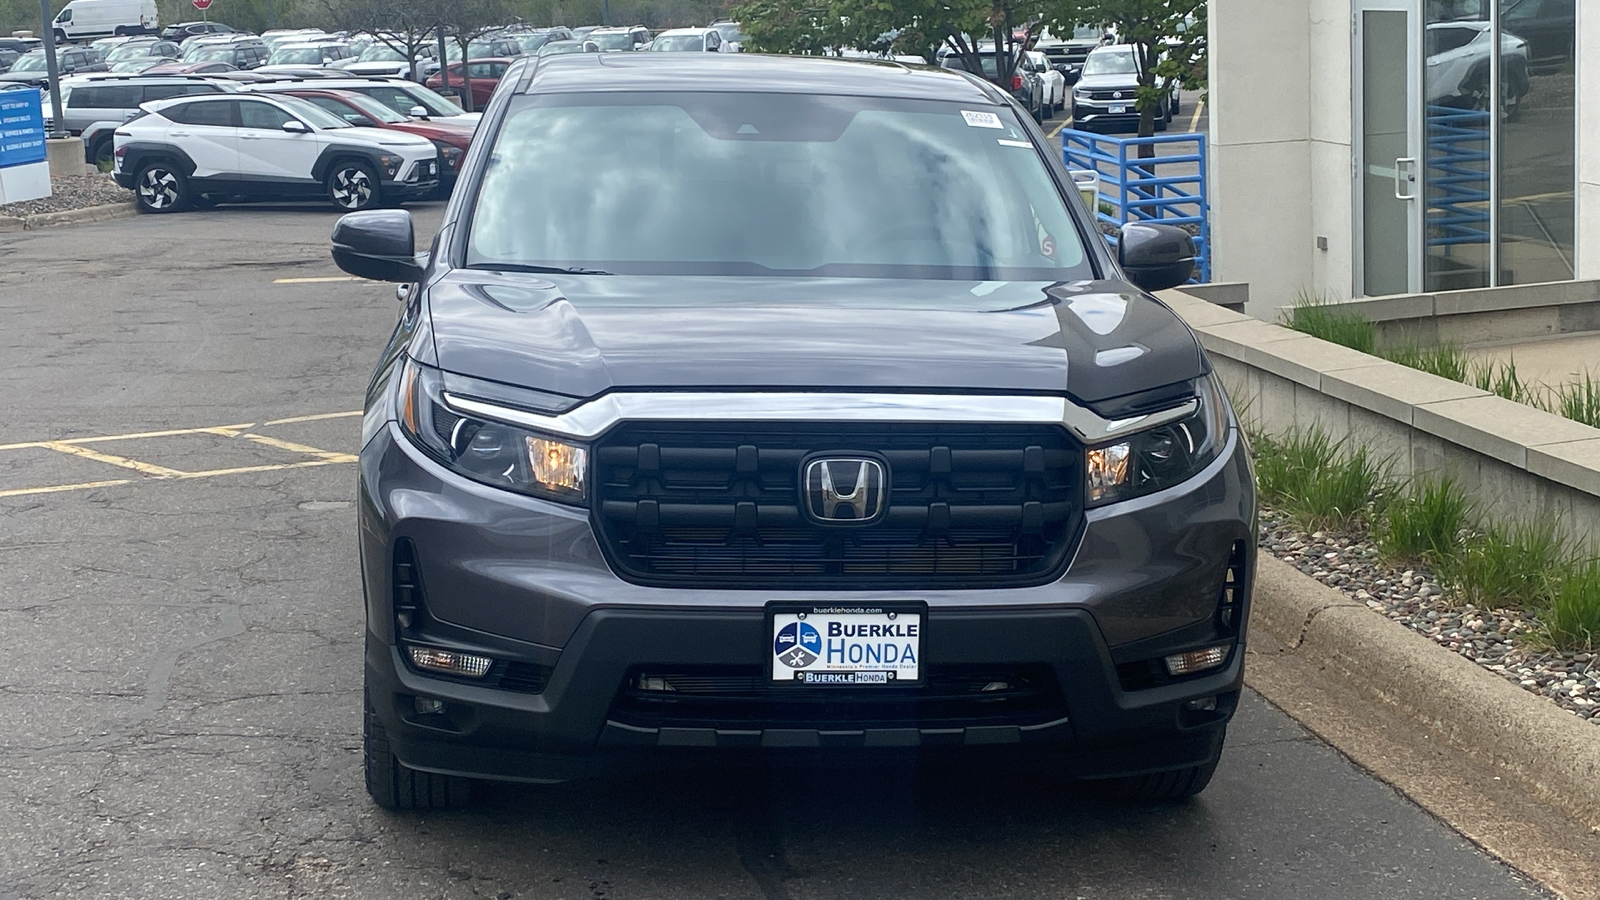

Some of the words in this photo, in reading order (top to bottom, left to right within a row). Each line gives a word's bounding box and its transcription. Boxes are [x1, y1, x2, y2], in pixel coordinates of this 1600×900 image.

[813, 606, 883, 614] buerklehonda.com
[828, 621, 918, 637] BUERKLE
[826, 638, 916, 664] HONDA
[805, 672, 855, 683] BUERKLE
[856, 673, 885, 682] HONDA
